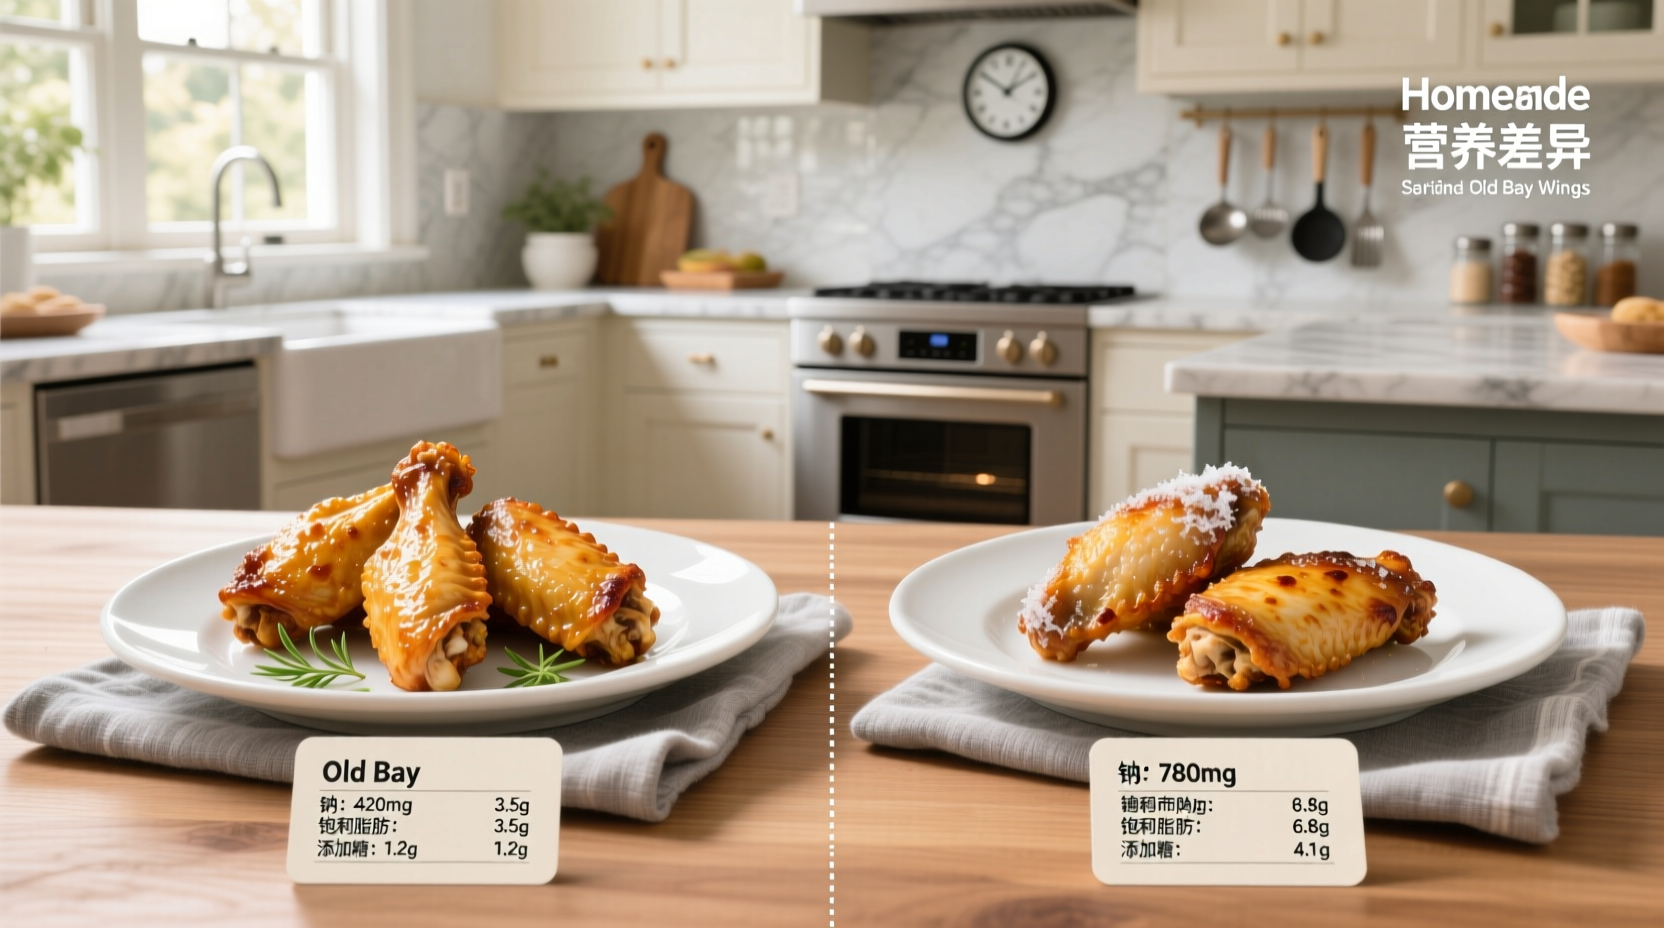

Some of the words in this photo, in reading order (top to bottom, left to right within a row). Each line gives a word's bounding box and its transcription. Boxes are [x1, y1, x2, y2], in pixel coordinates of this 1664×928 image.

[322, 758, 367, 783] Old
[373, 760, 421, 788] Bay
[494, 797, 530, 816] 3.5g
[494, 818, 529, 837] 3.5g
[1292, 819, 1330, 838] 6.8g
[494, 840, 528, 860] 1.2g
[1293, 841, 1330, 861] 4.1g
